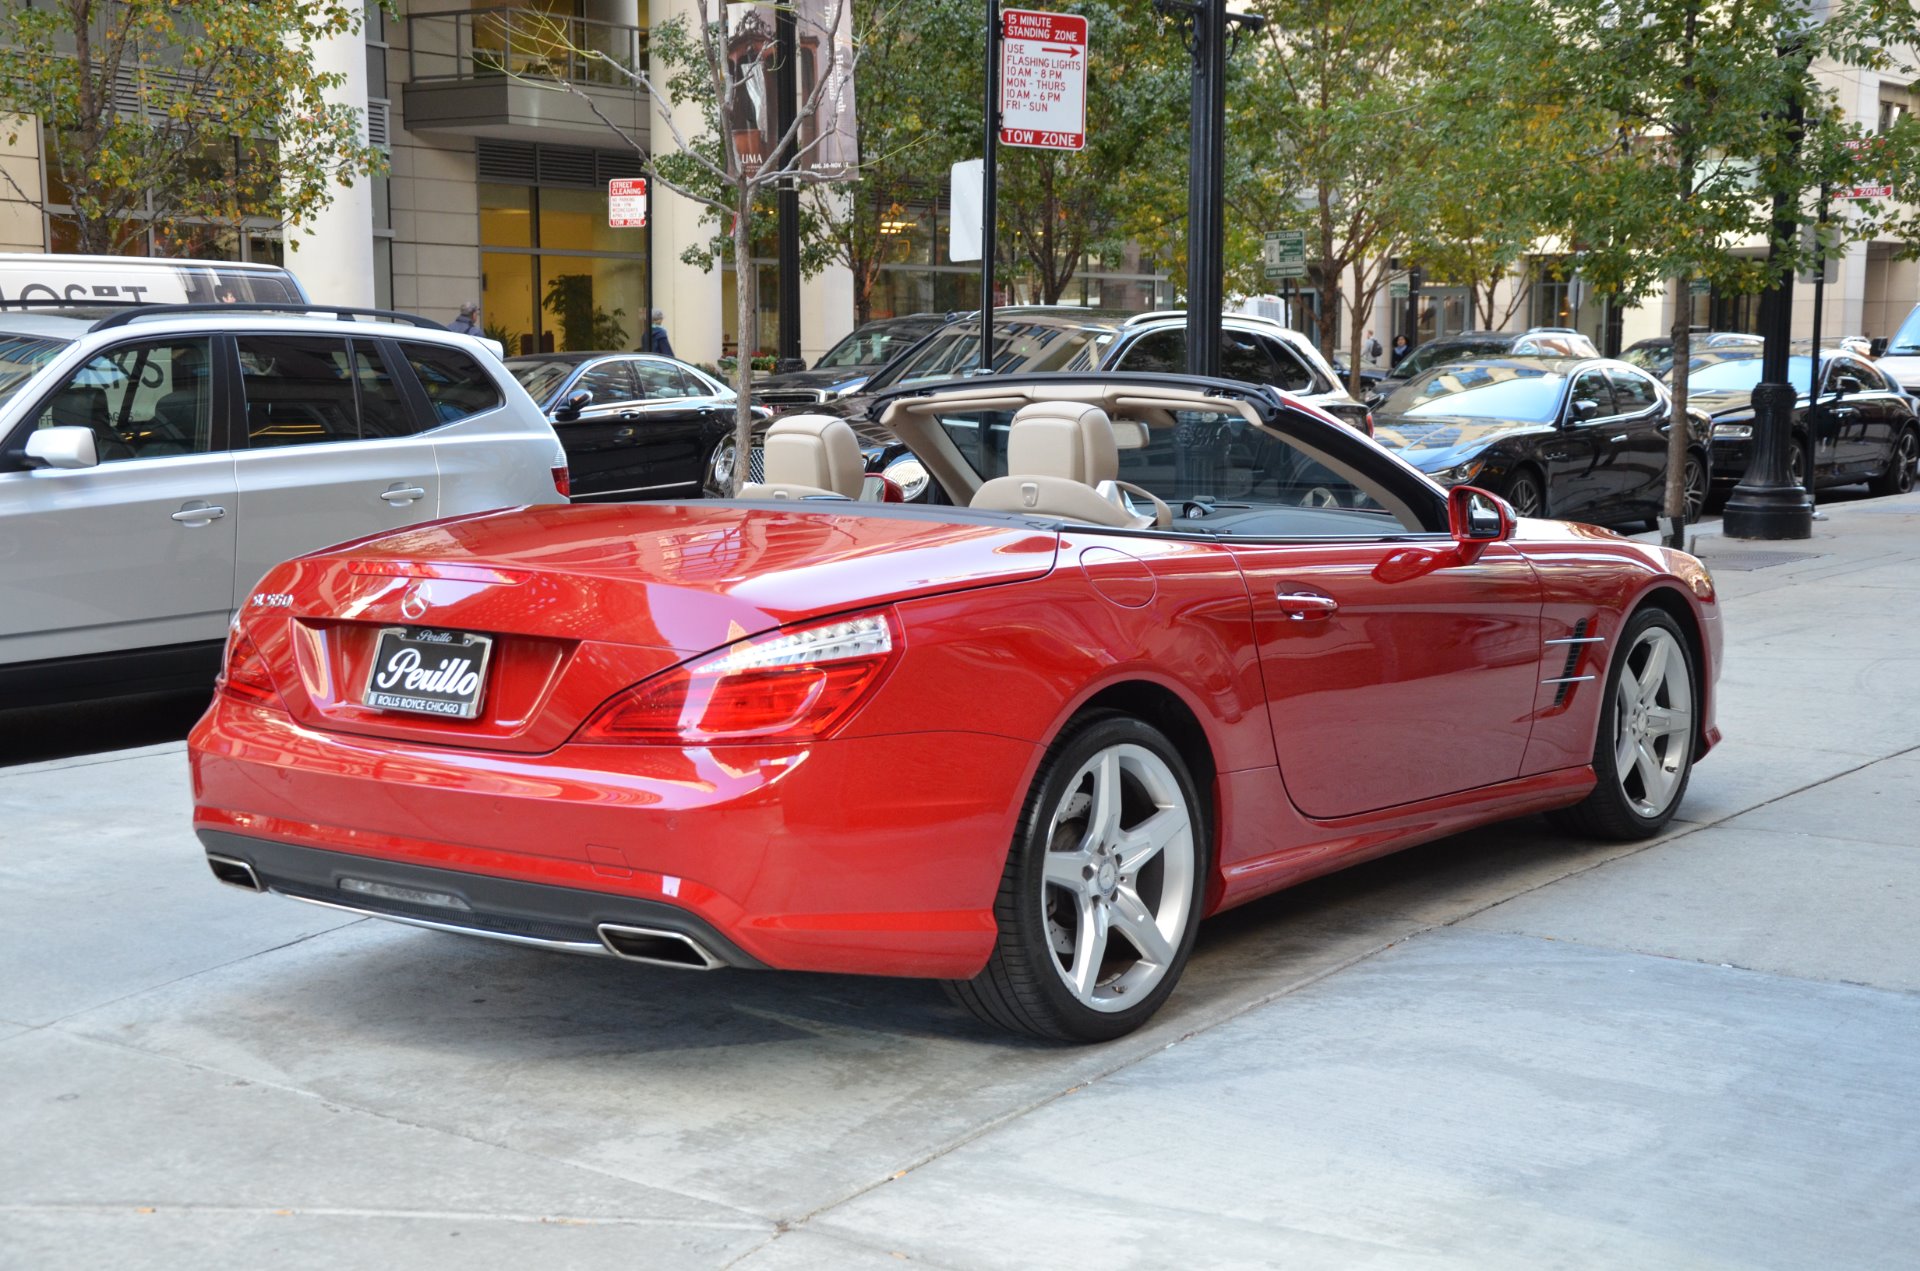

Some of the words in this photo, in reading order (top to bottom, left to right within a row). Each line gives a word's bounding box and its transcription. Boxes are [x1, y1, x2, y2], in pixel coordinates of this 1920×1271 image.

[1008, 14, 1017, 25] 15
[1020, 15, 1052, 28] MINUTE
[1008, 27, 1050, 40] STANDING
[1054, 30, 1077, 42] ZONE
[1007, 43, 1024, 54] USE
[1007, 55, 1049, 68] FLASHING
[1051, 60, 1081, 71] LIGHTS
[1040, 69, 1046, 79] 8
[1049, 70, 1063, 80] PM
[1006, 78, 1026, 88] MON
[1036, 80, 1066, 92] THURS
[1047, 92, 1061, 102] PM
[1006, 100, 1021, 110] FRI
[1029, 101, 1048, 112] SUN
[1005, 129, 1034, 144] TOW
[1040, 132, 1077, 147] ZONE
[612, 181, 633, 189] STREET
[1859, 187, 1887, 197] ZONE
[627, 218, 641, 226] ZONE
[416, 630, 453, 643] Perillo
[377, 648, 479, 695] Perillo
[377, 695, 400, 707] ROLLS
[400, 698, 426, 710] ROYCE
[426, 701, 459, 714] CHICAGO
